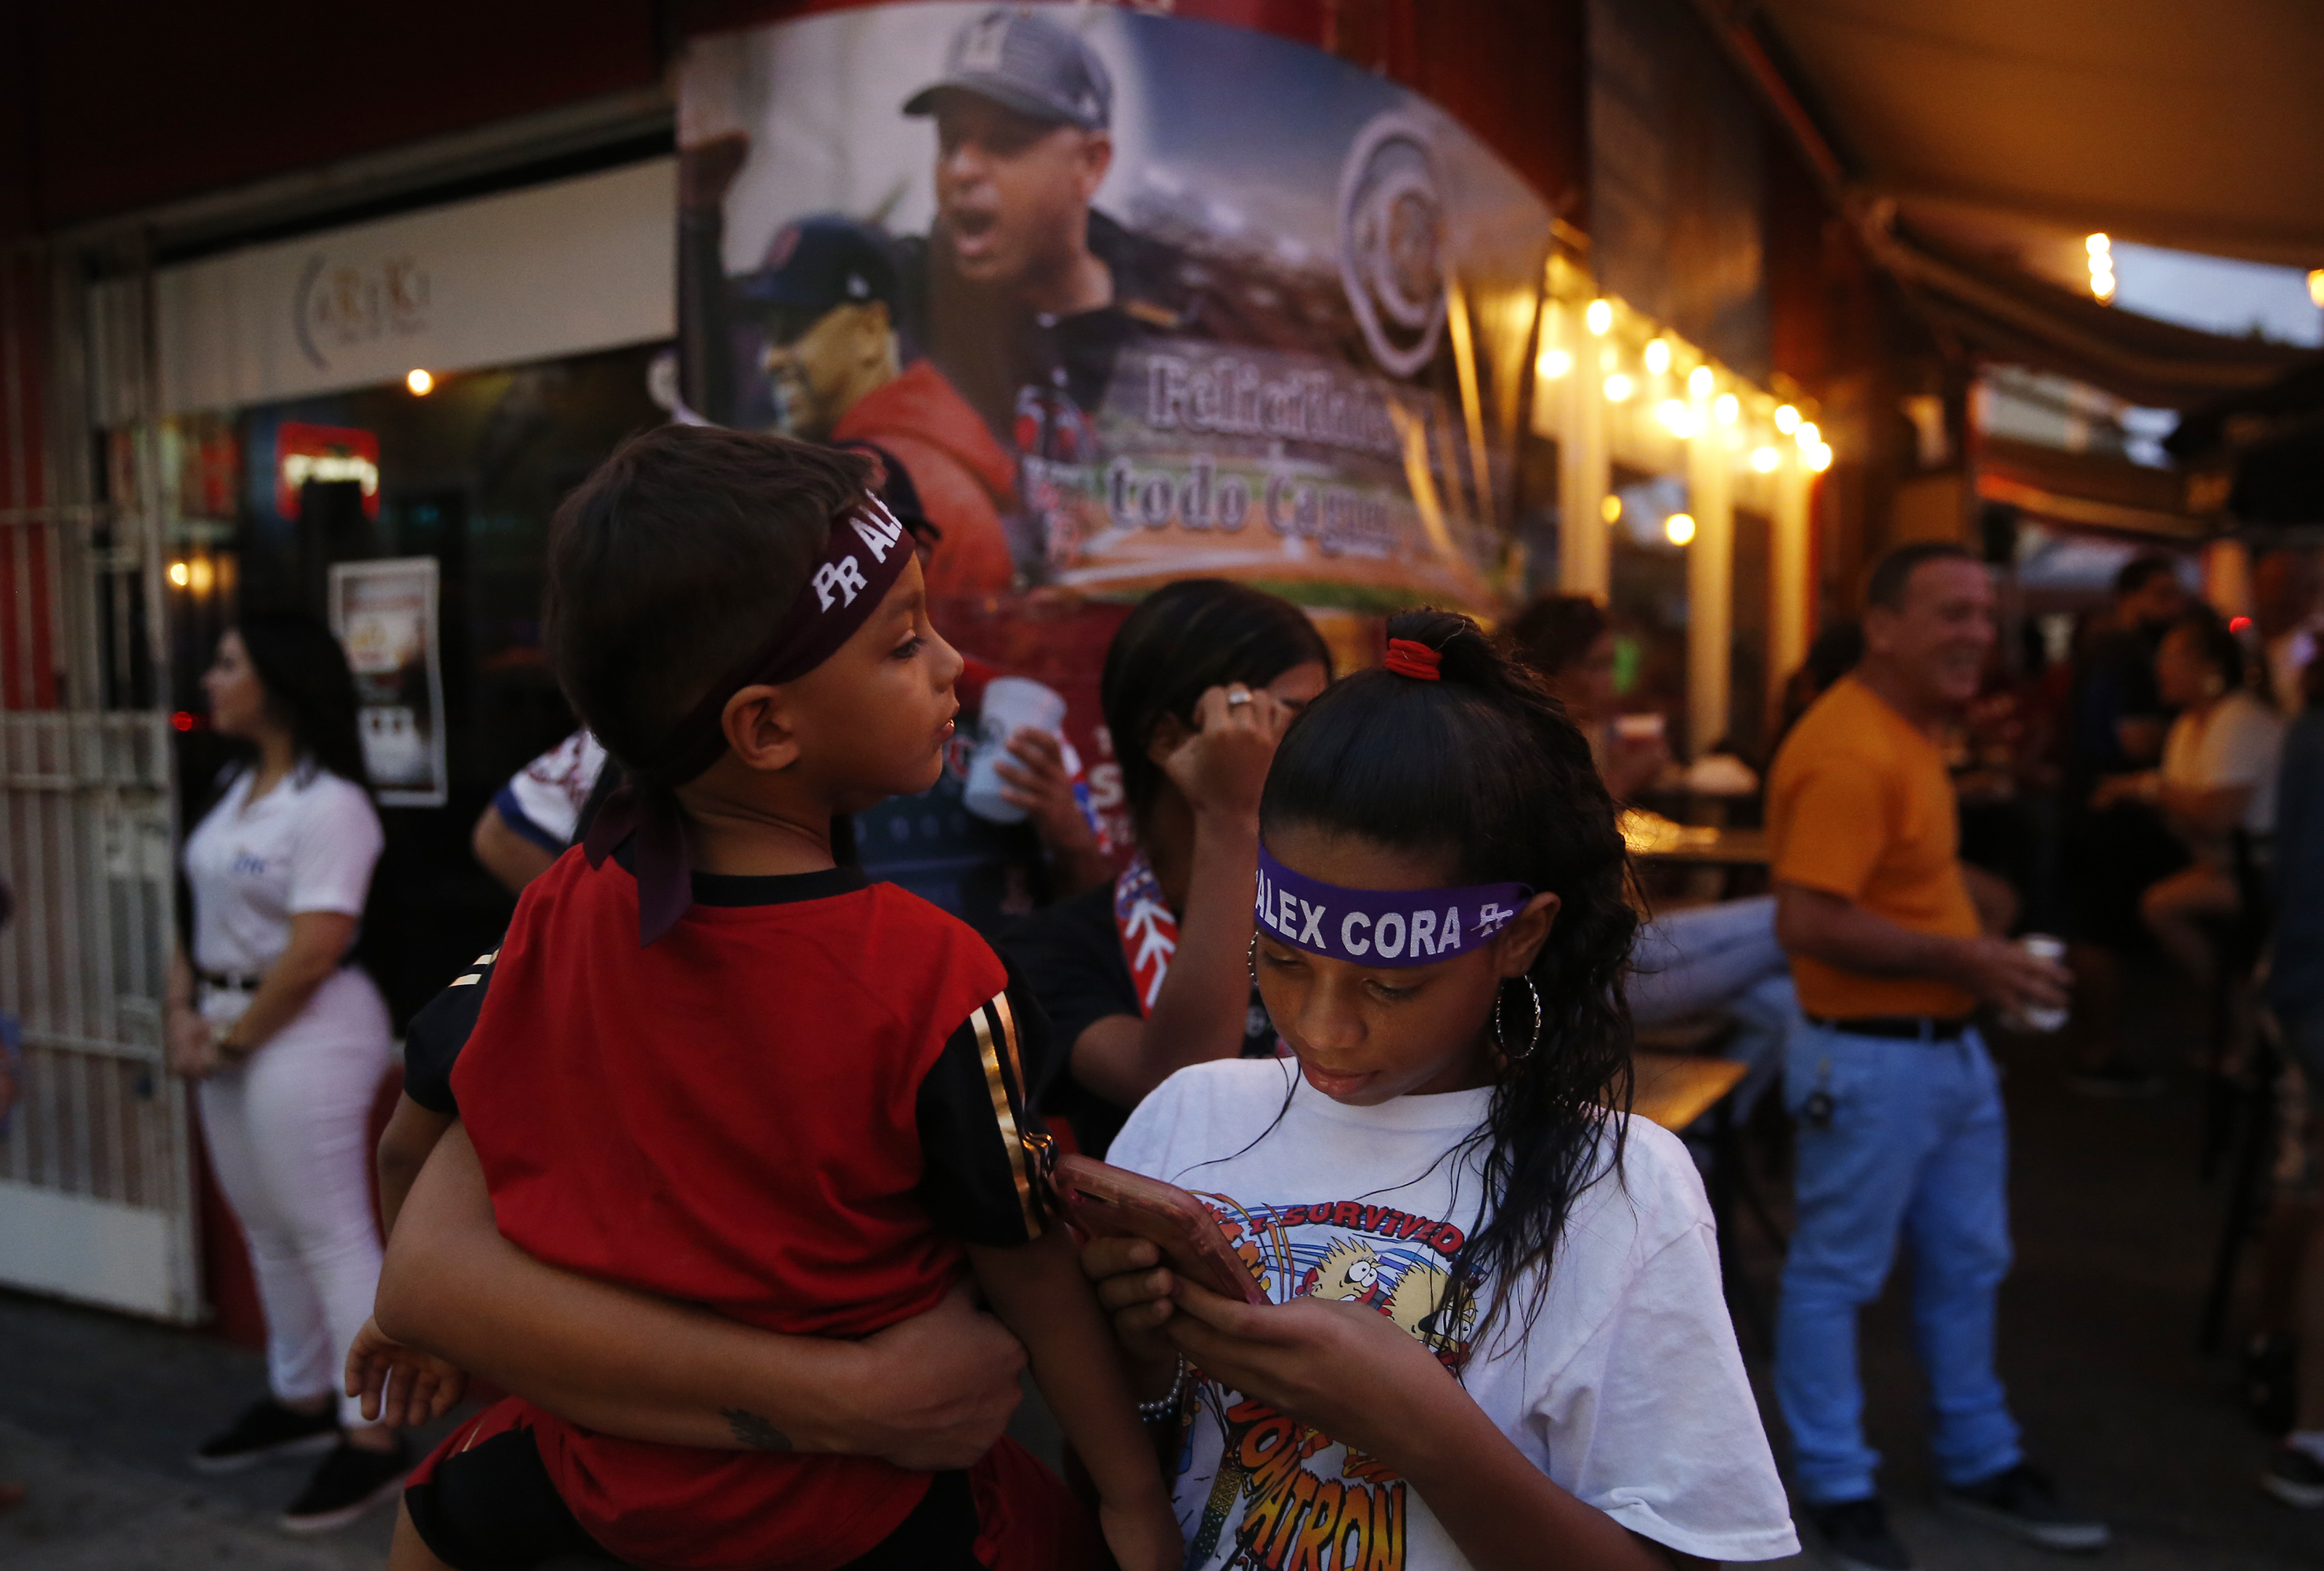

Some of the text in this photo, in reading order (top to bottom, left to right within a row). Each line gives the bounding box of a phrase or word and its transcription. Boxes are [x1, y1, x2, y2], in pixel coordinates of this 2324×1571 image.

[1108, 455, 1253, 532] todo
[810, 555, 868, 614] PR
[1256, 868, 1327, 949] ALEX
[1341, 906, 1461, 958] CORA
